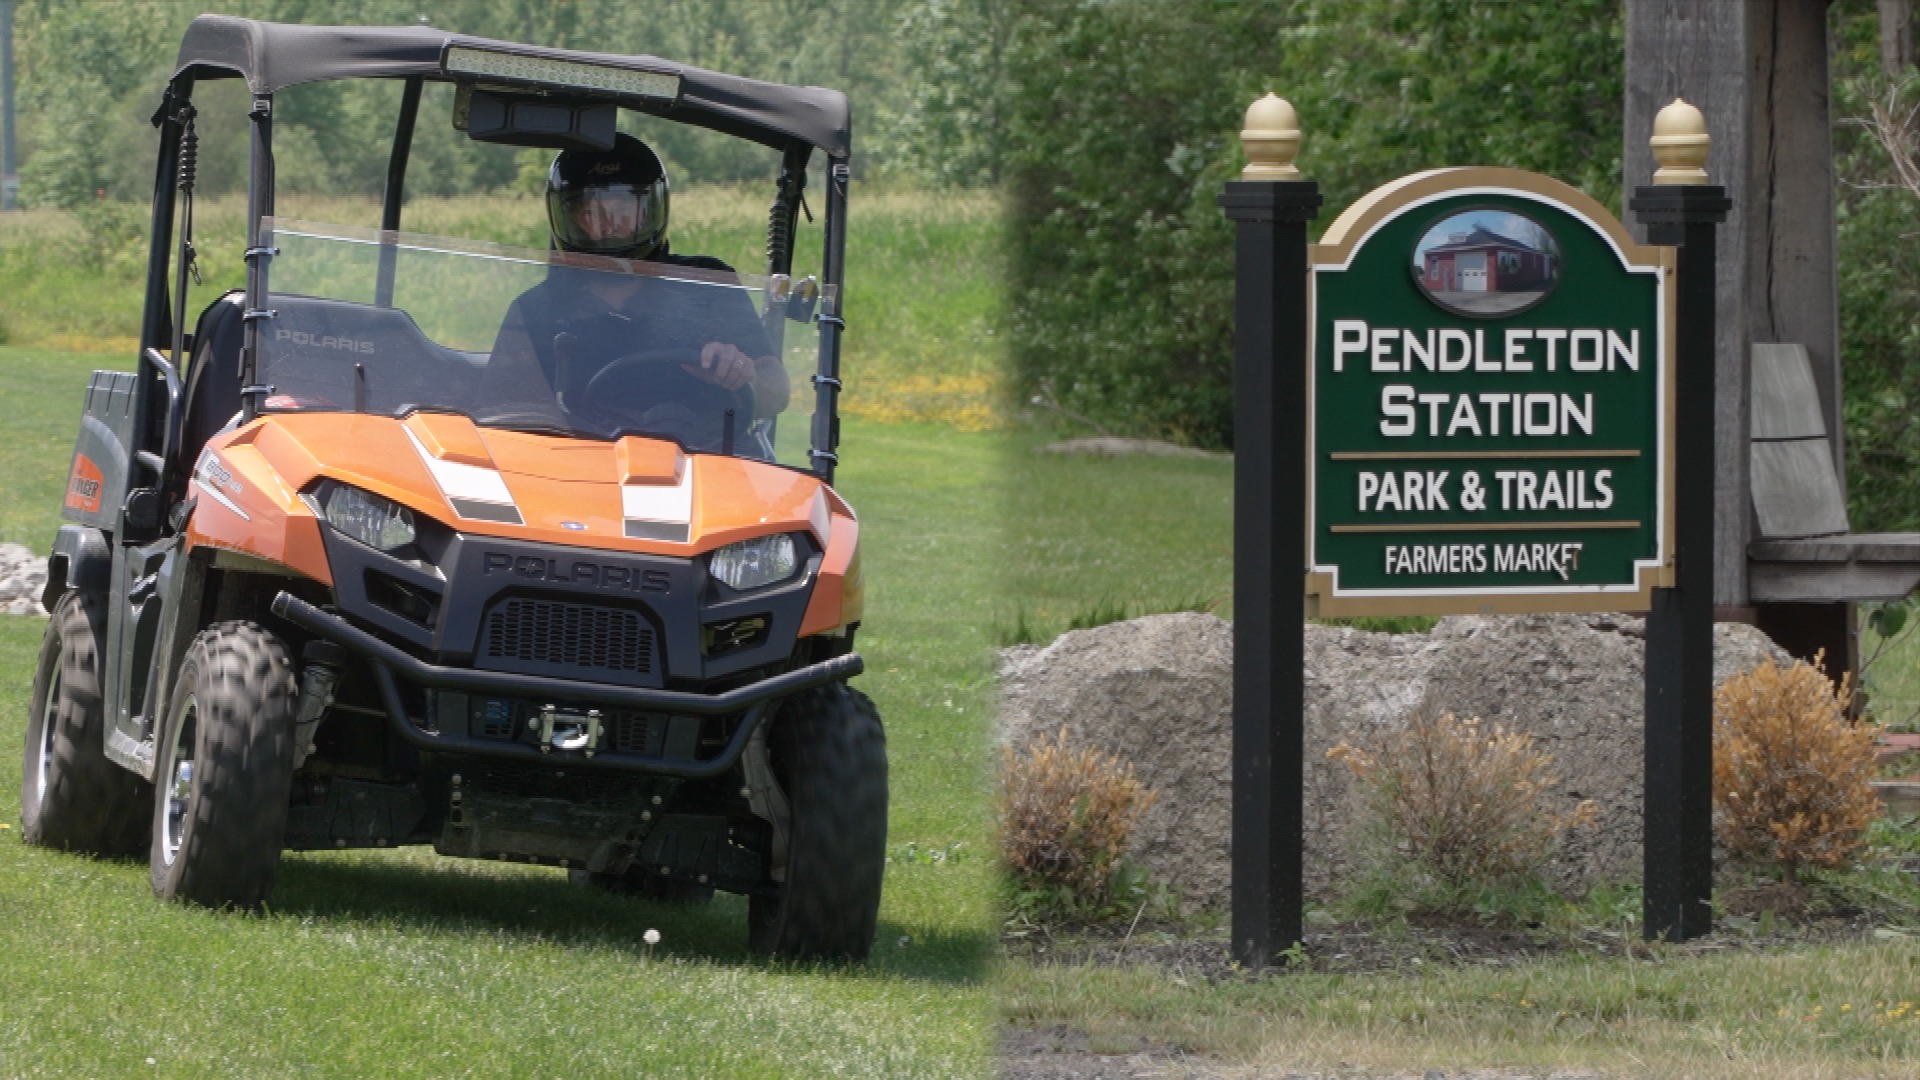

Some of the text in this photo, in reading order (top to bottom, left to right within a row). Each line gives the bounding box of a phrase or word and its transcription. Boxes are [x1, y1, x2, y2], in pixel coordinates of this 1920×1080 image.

[275, 329, 375, 354] POLARIS
[1333, 320, 1639, 372] PENDLETON
[1380, 385, 1593, 436] STATION
[1358, 470, 1614, 511] PARK & TRAILS
[484, 552, 670, 593] POLARIS
[1385, 545, 1487, 574] FARMERS
